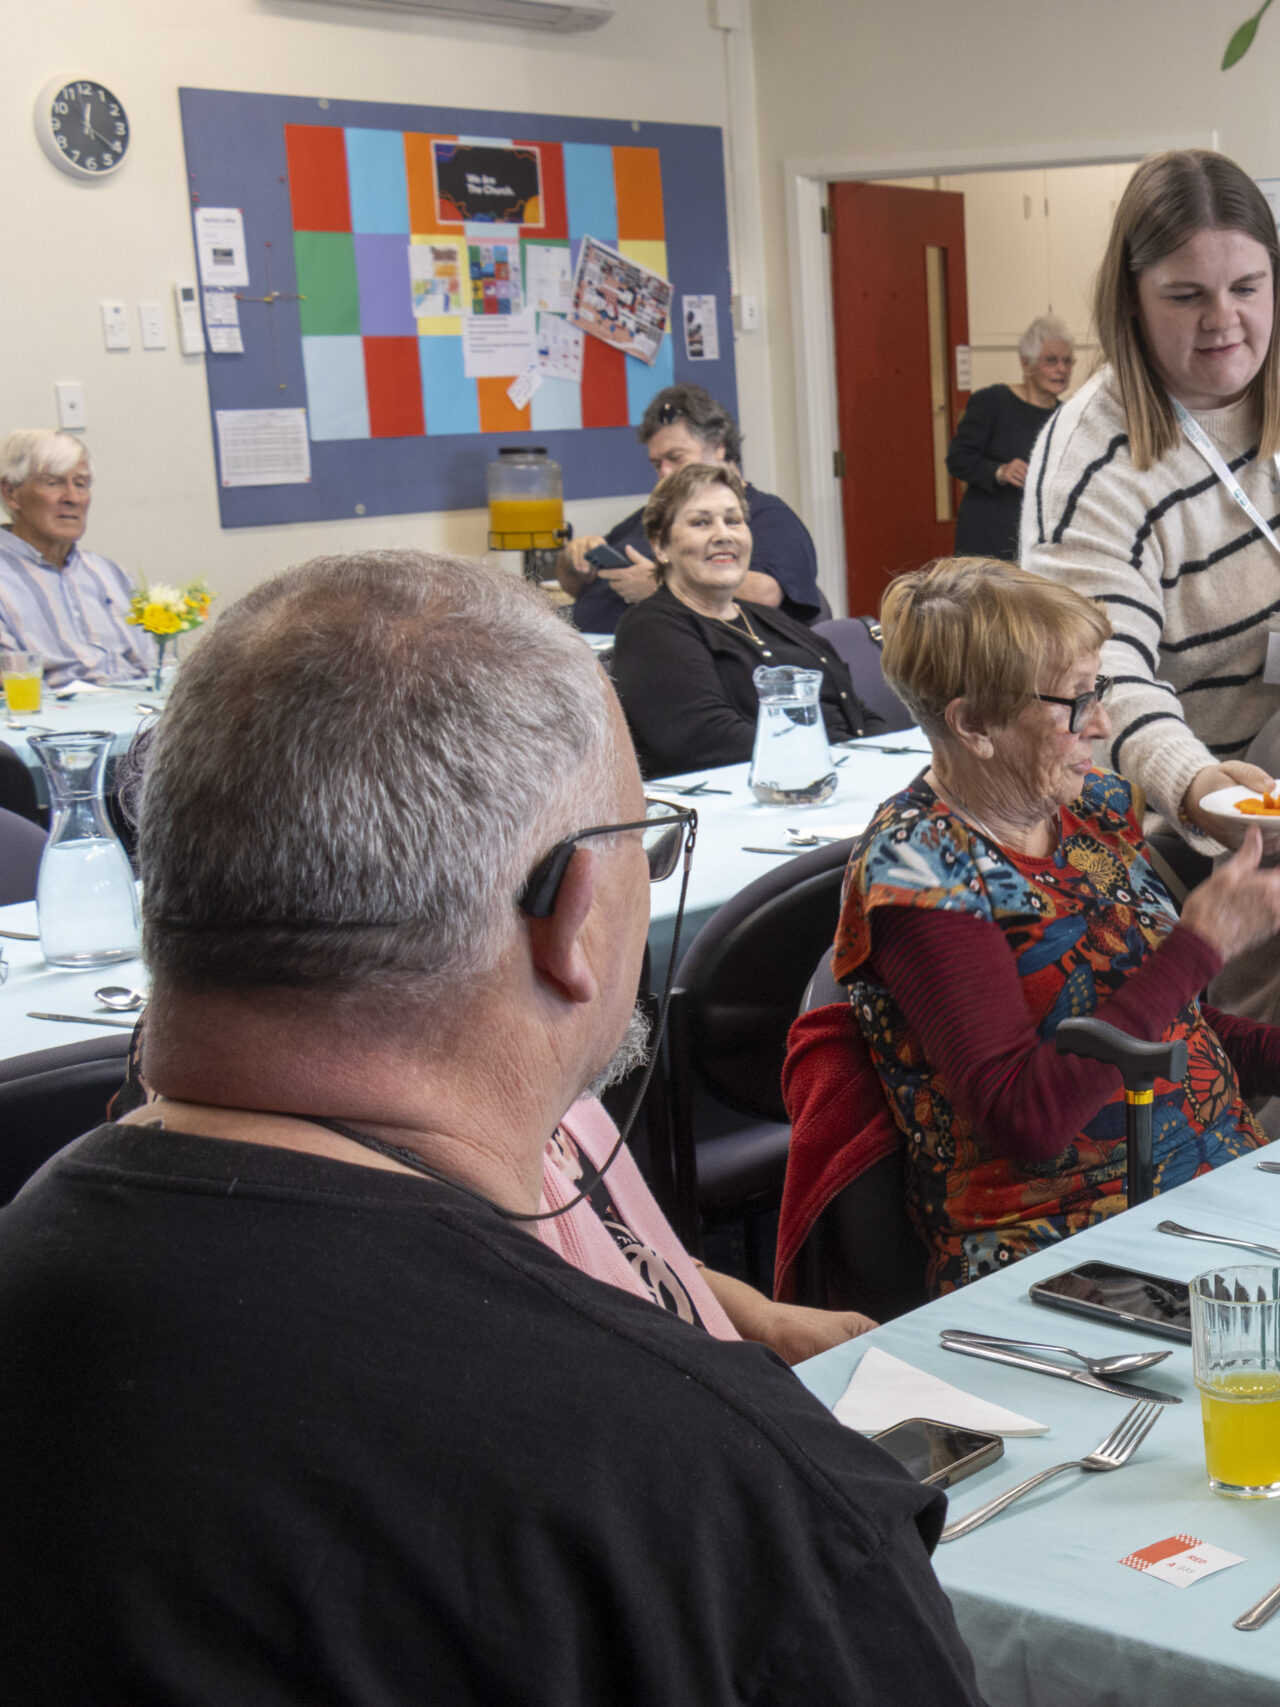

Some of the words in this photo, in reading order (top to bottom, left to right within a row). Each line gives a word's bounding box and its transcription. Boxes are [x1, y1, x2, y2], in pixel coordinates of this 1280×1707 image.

[63, 88, 75, 100] 11
[76, 83, 93, 95] 12
[97, 89, 106, 102] 1
[53, 101, 69, 115] 10
[109, 103, 120, 117] 2
[114, 120, 126, 136] 3
[70, 149, 81, 162] 7
[103, 152, 114, 166] 5
[85, 156, 98, 171] 6
[1186, 1554, 1208, 1565] RED
